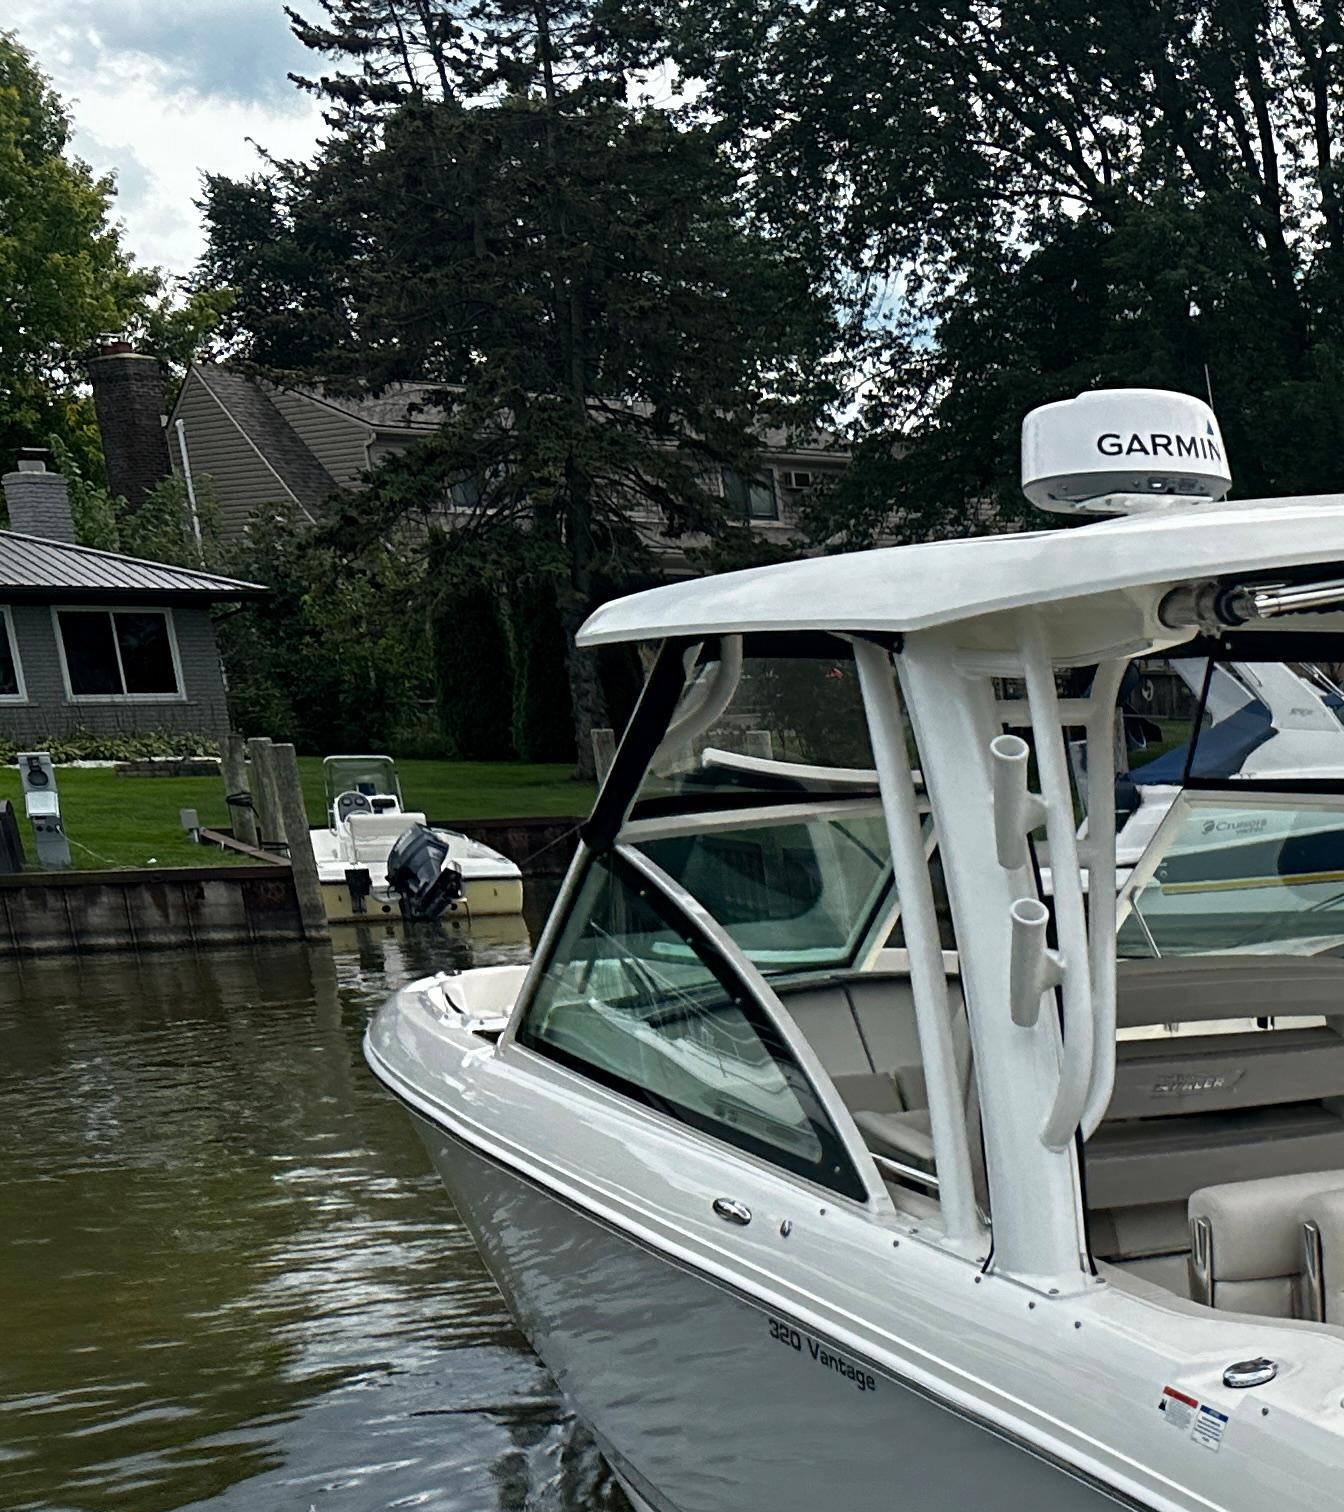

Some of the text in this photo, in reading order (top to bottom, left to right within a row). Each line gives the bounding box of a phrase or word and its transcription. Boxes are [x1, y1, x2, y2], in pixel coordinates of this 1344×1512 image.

[1097, 433, 1222, 462] GARMIN
[768, 1318, 875, 1391] 320 Vantage
